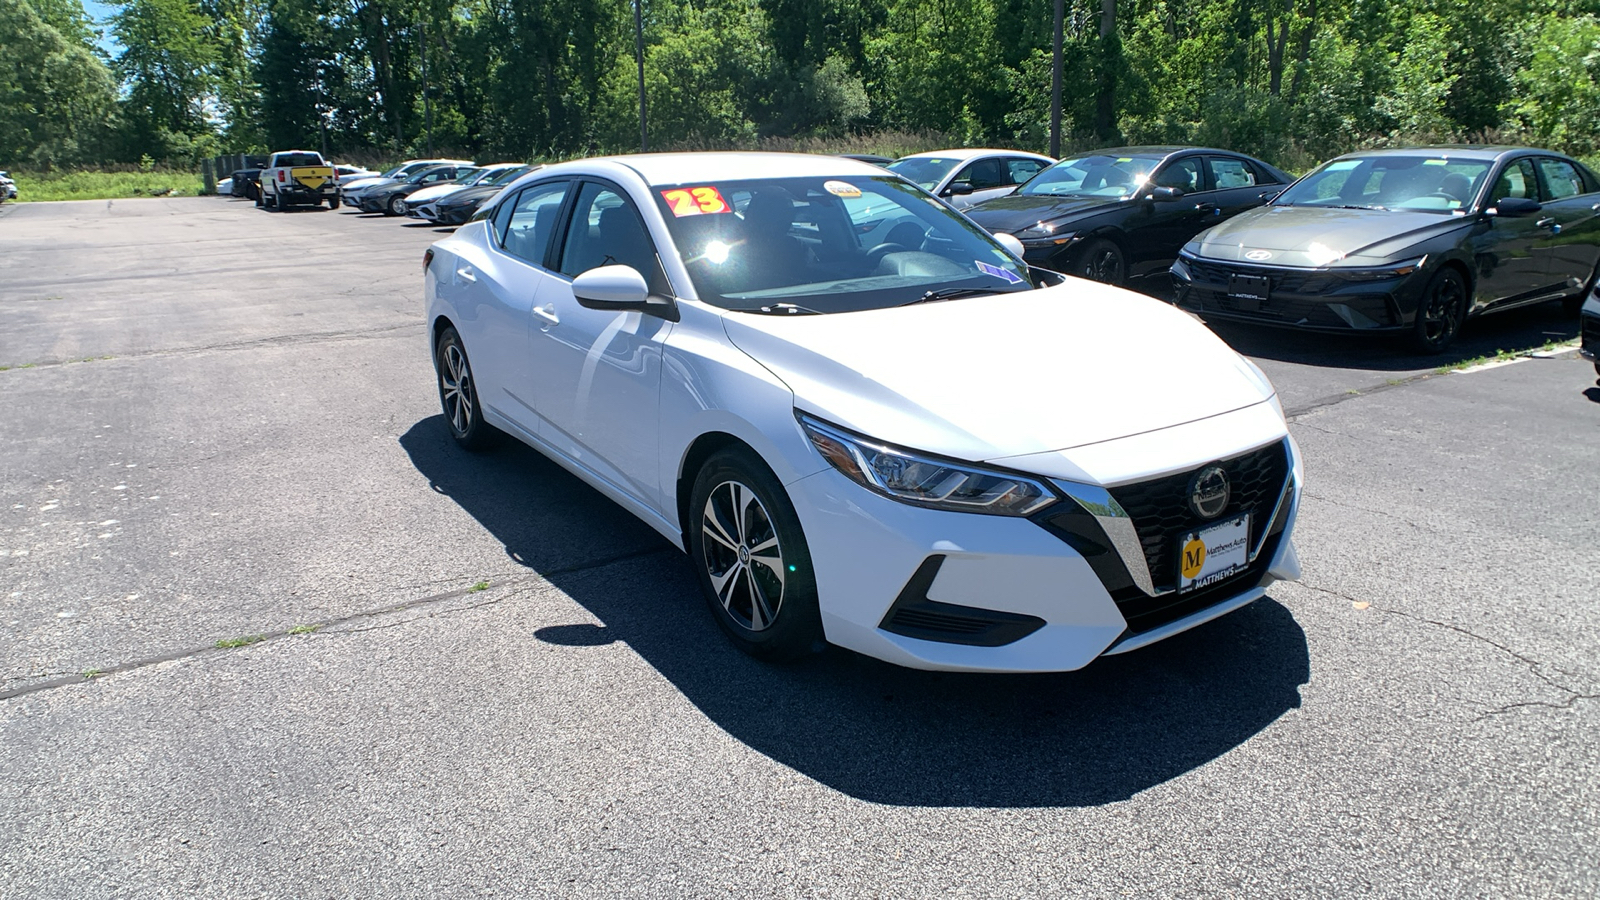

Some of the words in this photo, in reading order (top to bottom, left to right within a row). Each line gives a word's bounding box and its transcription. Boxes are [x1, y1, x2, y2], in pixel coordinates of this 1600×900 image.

[665, 187, 725, 215] 23
[1206, 542, 1233, 556] Matthews
[1233, 537, 1247, 547] Auto
[1184, 547, 1202, 572] M
[1195, 566, 1234, 590] MATTHEWS
